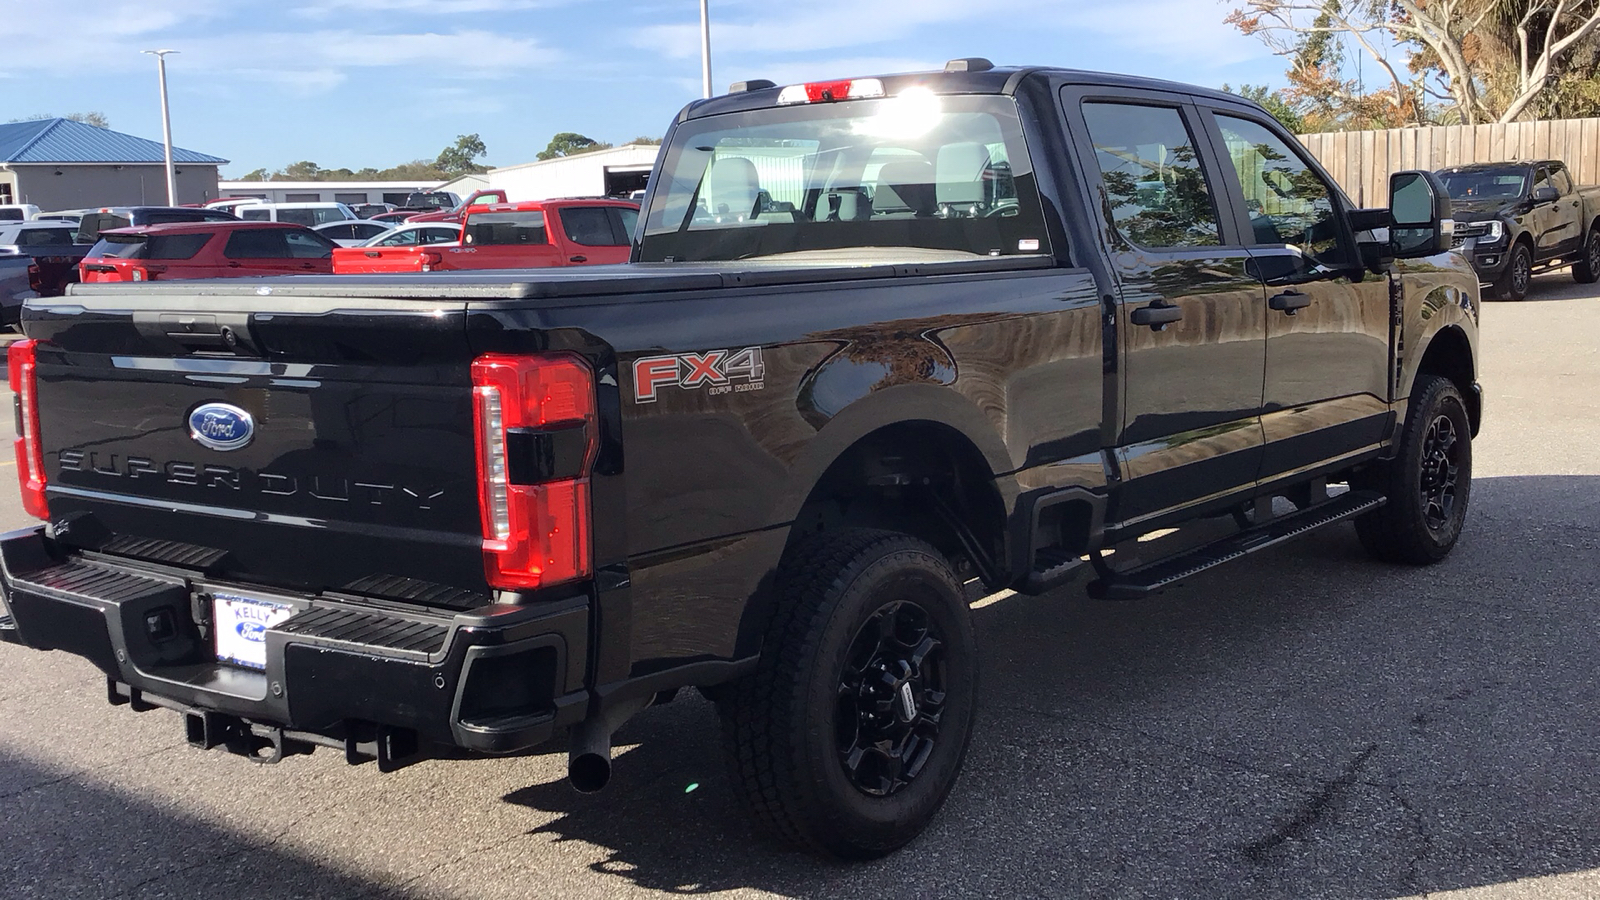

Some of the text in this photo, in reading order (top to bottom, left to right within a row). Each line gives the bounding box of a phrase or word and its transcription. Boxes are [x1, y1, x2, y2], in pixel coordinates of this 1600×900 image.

[633, 346, 766, 404] FX4
[709, 386, 732, 396] OFF
[202, 412, 235, 437] Ford
[58, 450, 444, 510] SUPER DUTY
[234, 607, 270, 622] KELLY
[241, 622, 267, 641] Ford
